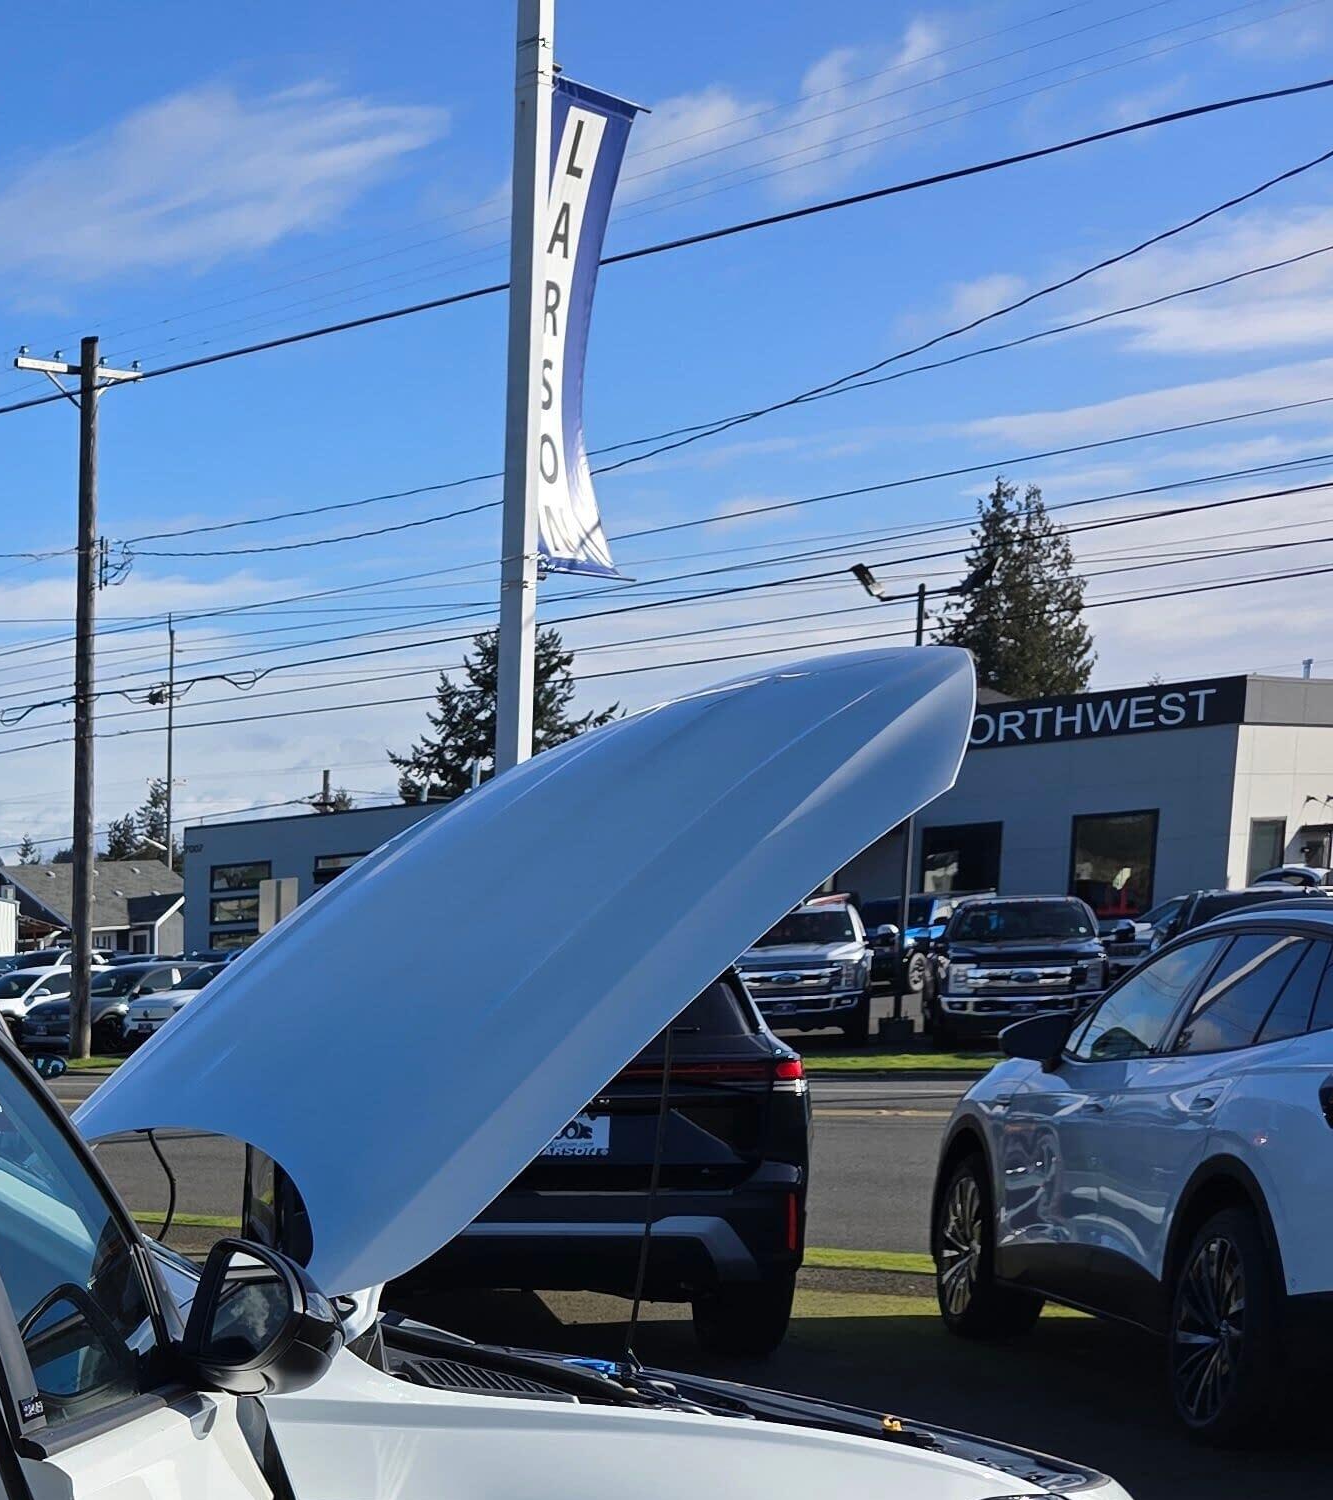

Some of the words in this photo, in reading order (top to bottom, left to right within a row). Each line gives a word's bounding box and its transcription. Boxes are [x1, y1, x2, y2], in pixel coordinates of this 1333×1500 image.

[539, 119, 585, 552] LARSON
[970, 688, 1217, 744] ORTHWEST
[540, 1146, 598, 1156] ARSON
